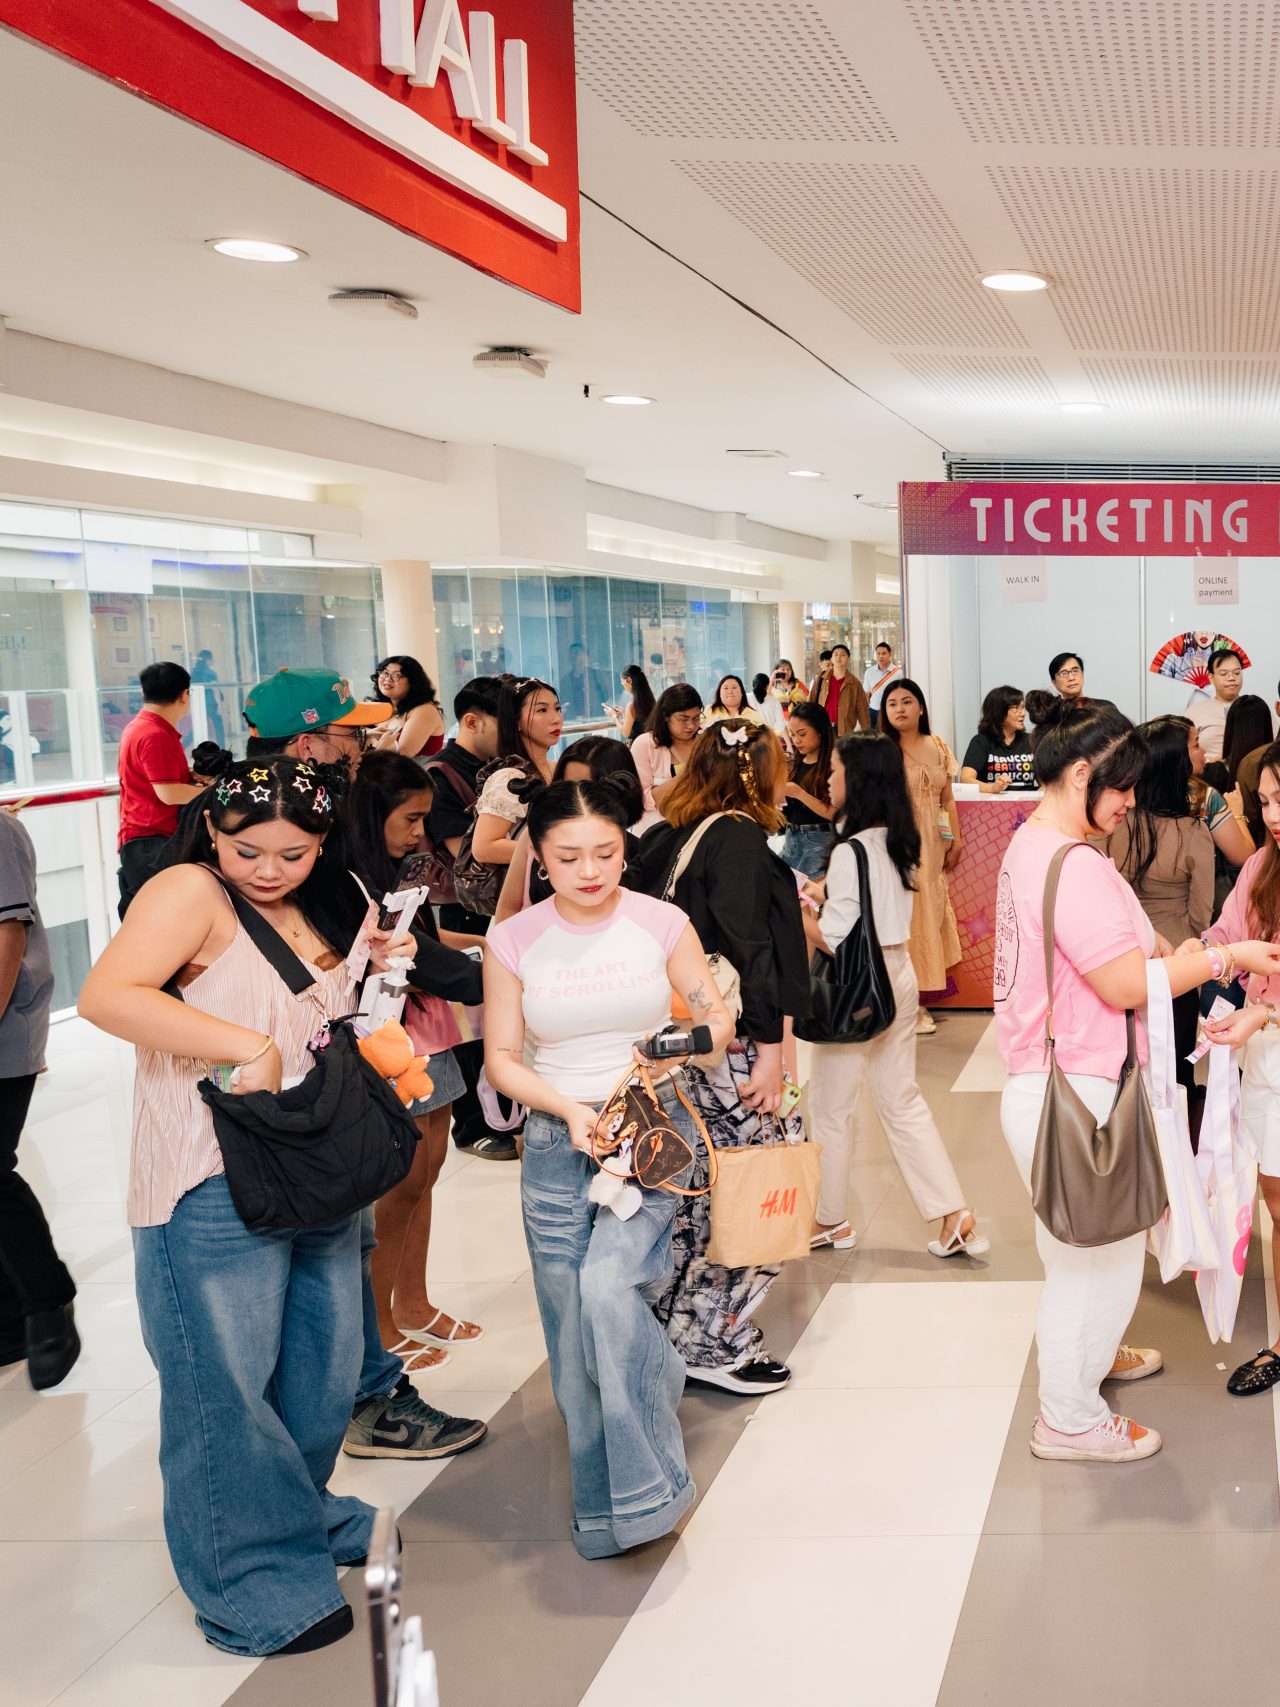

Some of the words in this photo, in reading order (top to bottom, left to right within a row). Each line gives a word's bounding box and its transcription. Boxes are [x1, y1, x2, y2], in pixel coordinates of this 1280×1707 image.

[970, 498, 1248, 543] TICKETING
[1006, 576, 1029, 584] WALK
[1198, 577, 1229, 585] ONLINE
[1198, 587, 1233, 597] payment
[986, 762, 1034, 772] BEAUCO
[554, 966, 590, 981] THE
[594, 960, 629, 977] ART
[548, 968, 661, 999] SCROLLING
[760, 1187, 797, 1218] H&M
